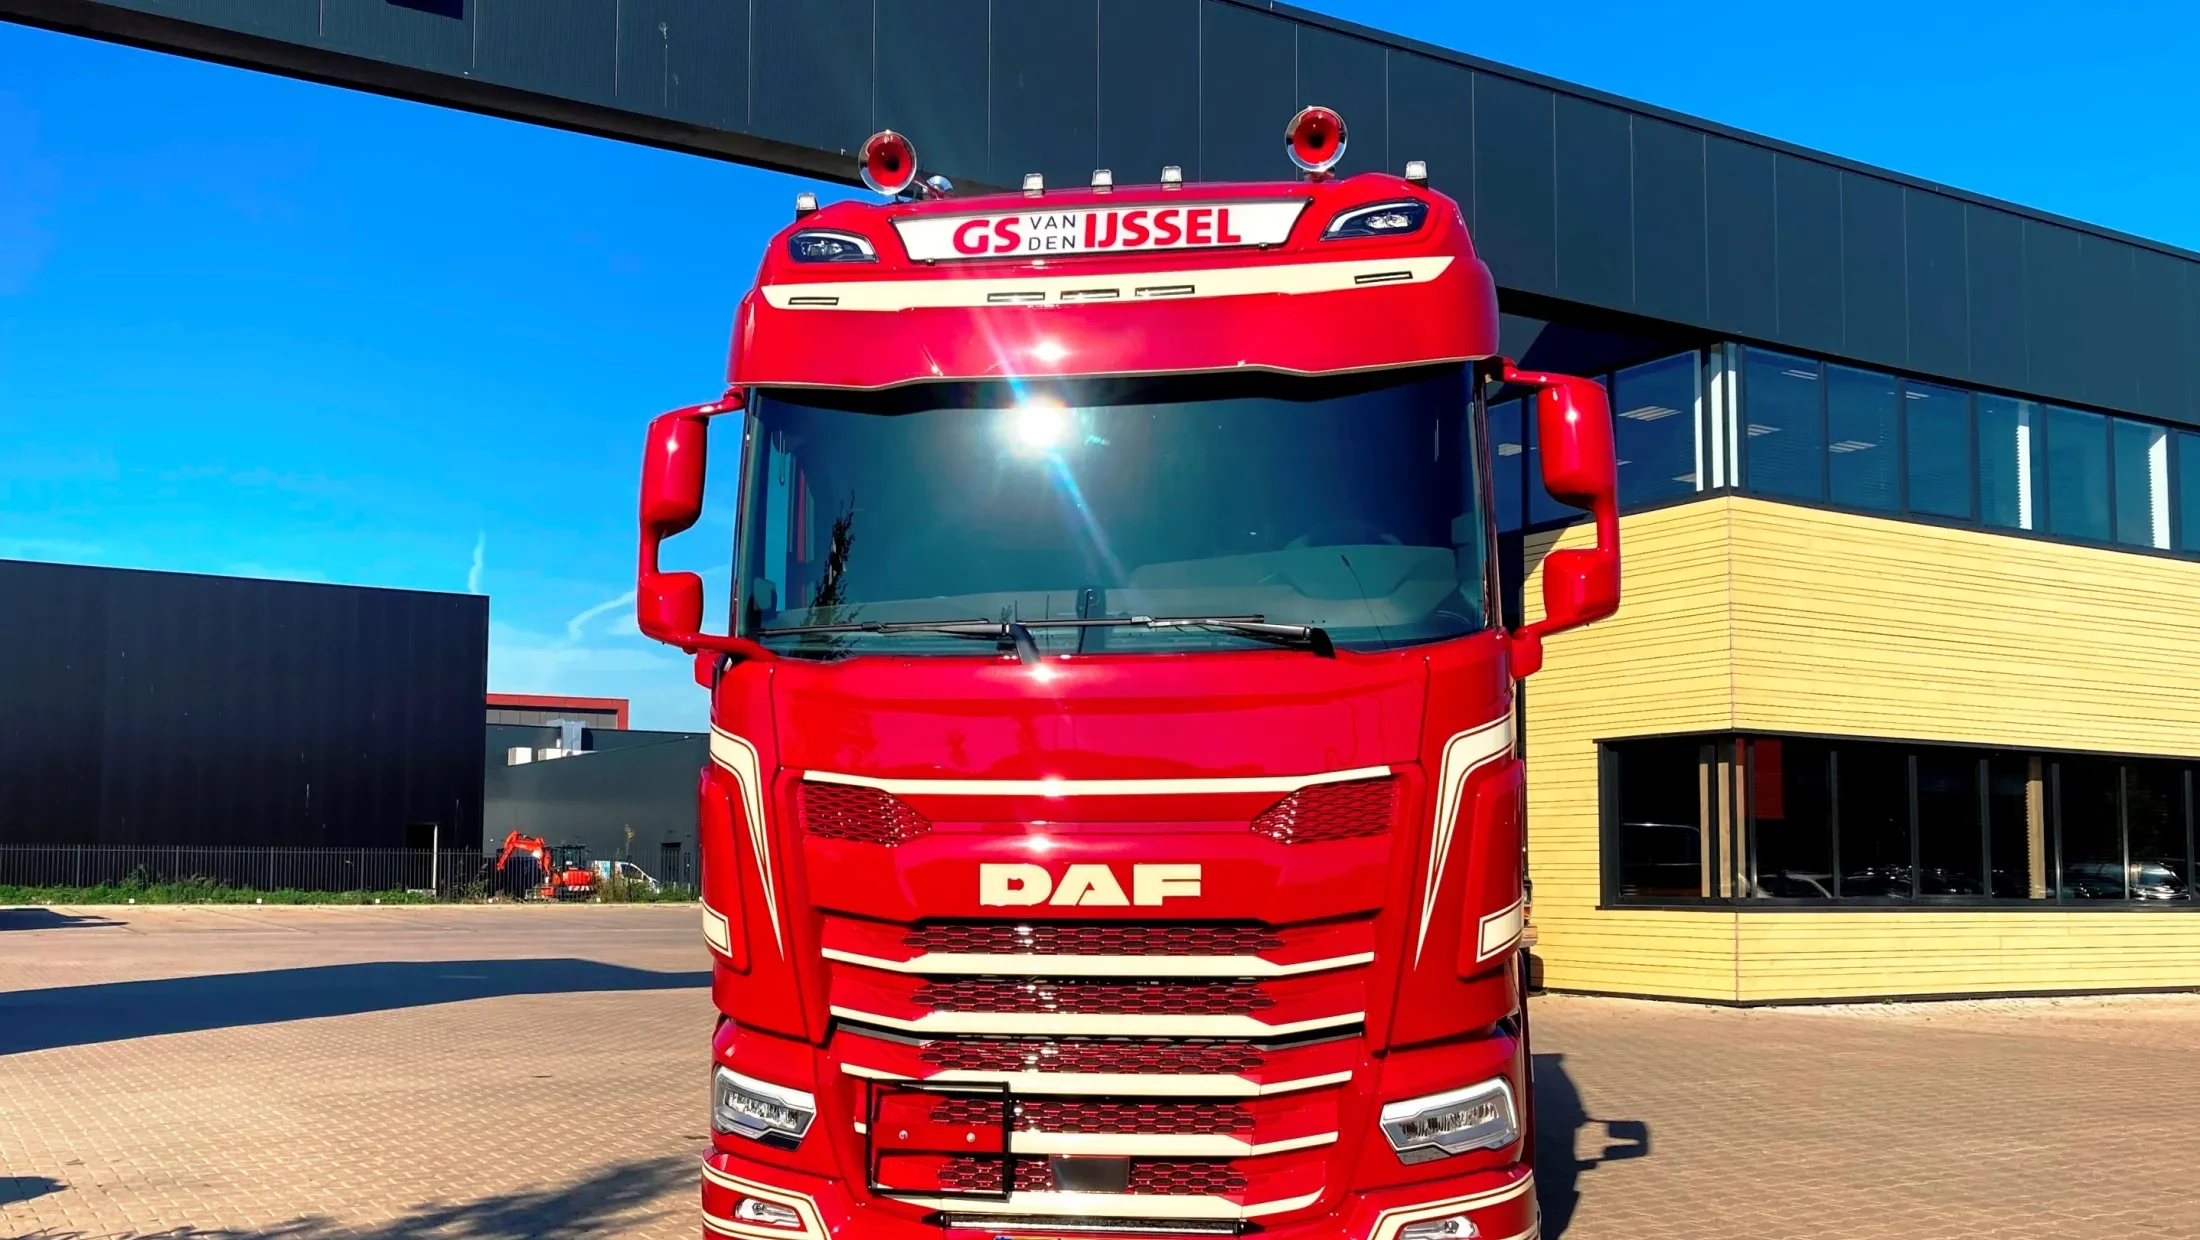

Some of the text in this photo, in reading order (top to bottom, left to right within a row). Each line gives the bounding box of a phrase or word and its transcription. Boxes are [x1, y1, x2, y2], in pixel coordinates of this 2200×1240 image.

[952, 216, 1021, 255] GS
[1029, 214, 1076, 231] VAN
[1084, 208, 1242, 249] IJSSEL
[1028, 234, 1076, 251] DEN
[979, 863, 1202, 907] DAF
